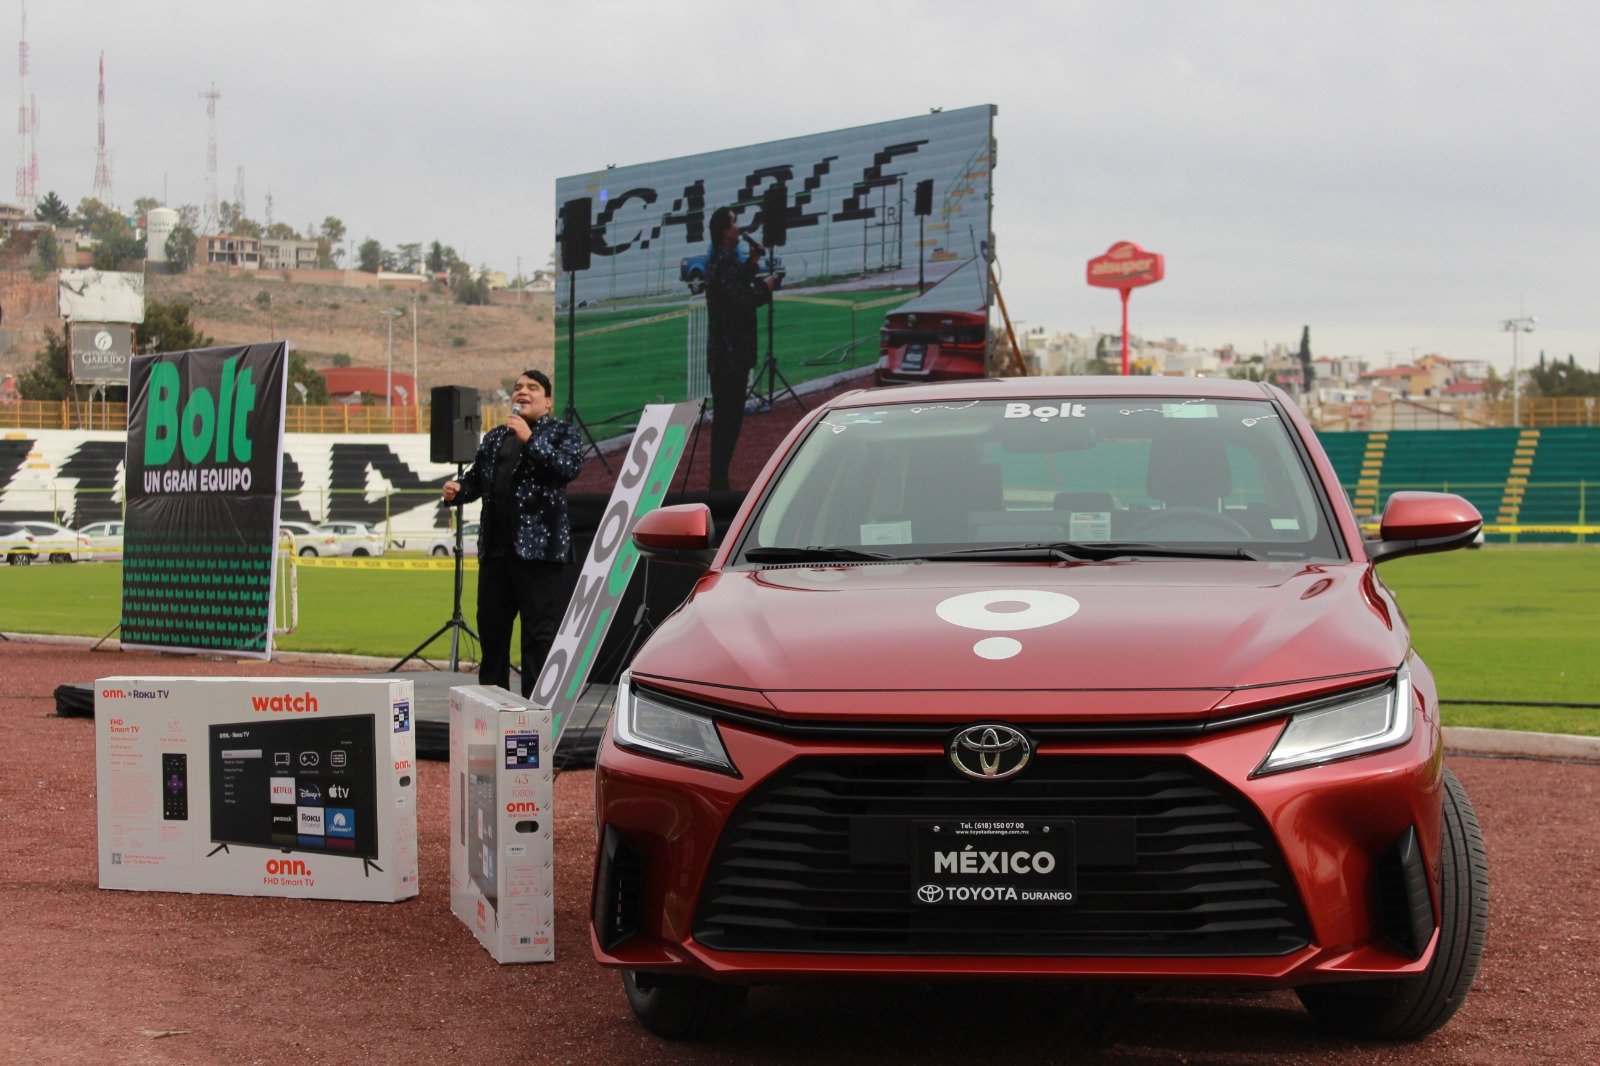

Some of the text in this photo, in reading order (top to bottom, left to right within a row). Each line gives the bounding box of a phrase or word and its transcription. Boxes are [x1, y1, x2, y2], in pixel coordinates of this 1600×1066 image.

[144, 354, 256, 466] Bolt
[1004, 402, 1086, 422] Bolt
[144, 467, 252, 493] UN GRAN EQUIPO
[102, 689, 169, 699] onn. Roku TV
[251, 691, 318, 712] watch
[110, 718, 123, 726] FHD
[394, 760, 411, 770] onn.
[273, 786, 293, 795] NETFLIX
[337, 785, 349, 799] tv
[506, 801, 540, 813] onn.
[301, 813, 321, 822] Roku
[974, 822, 991, 830] (618)
[934, 844, 1056, 874] MÉXICO
[266, 859, 312, 876] onn.
[263, 877, 315, 887] FHD Smart TV
[946, 887, 1073, 901] TOYOTA DURANGO
